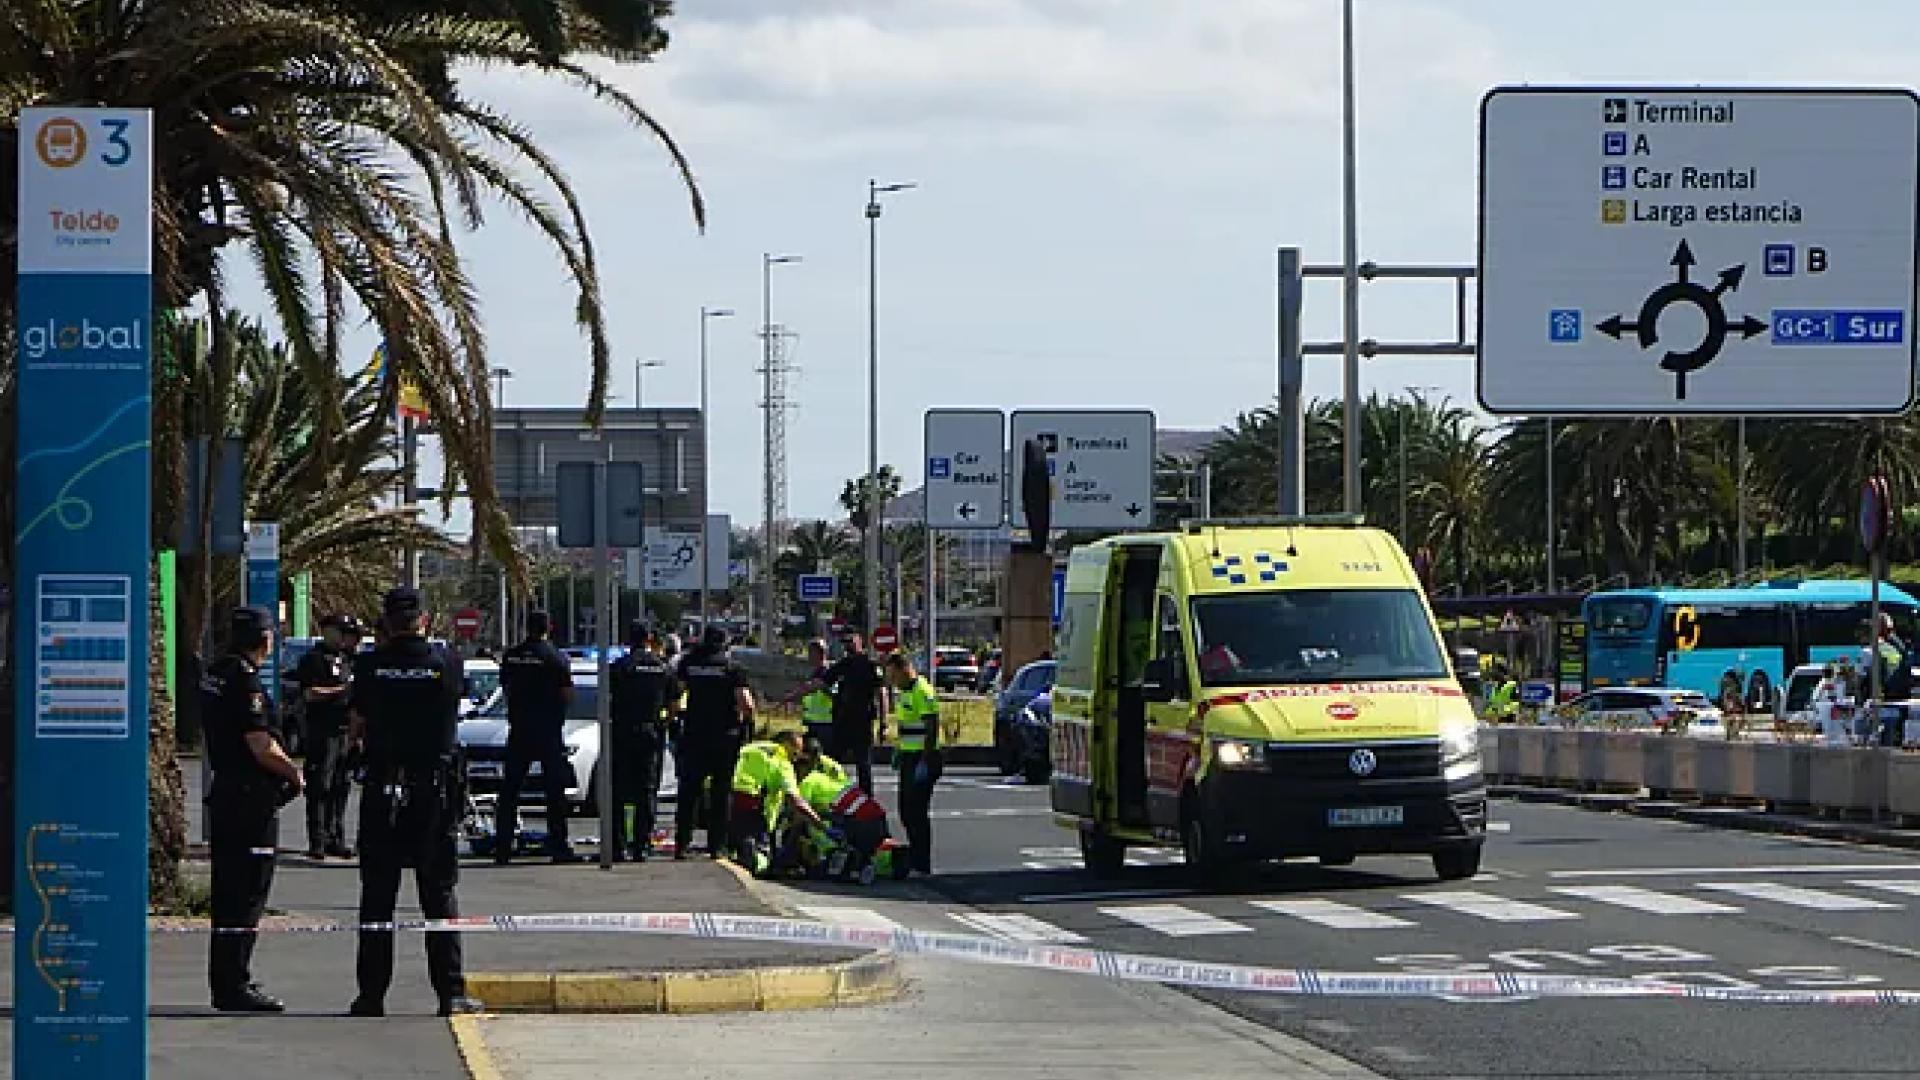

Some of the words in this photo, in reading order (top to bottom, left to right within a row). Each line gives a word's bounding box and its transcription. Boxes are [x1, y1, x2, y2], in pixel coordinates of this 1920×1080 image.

[1634, 100, 1733, 123] Terminal
[100, 118, 131, 168] 3
[1634, 134, 1650, 156] A
[1634, 166, 1673, 189] Car
[1681, 166, 1756, 189] Rental
[49, 207, 120, 233] Telde
[1634, 200, 1696, 226] Larga
[1705, 200, 1801, 222] estancia
[1807, 247, 1828, 272] B
[24, 317, 143, 358] global
[1777, 316, 1830, 338] GC-1
[1849, 315, 1900, 338] Sur
[1066, 436, 1128, 449] Terminal
[954, 452, 981, 465] Car
[1066, 460, 1077, 474] A
[954, 473, 999, 483] Rental
[1064, 479, 1097, 492] Larga
